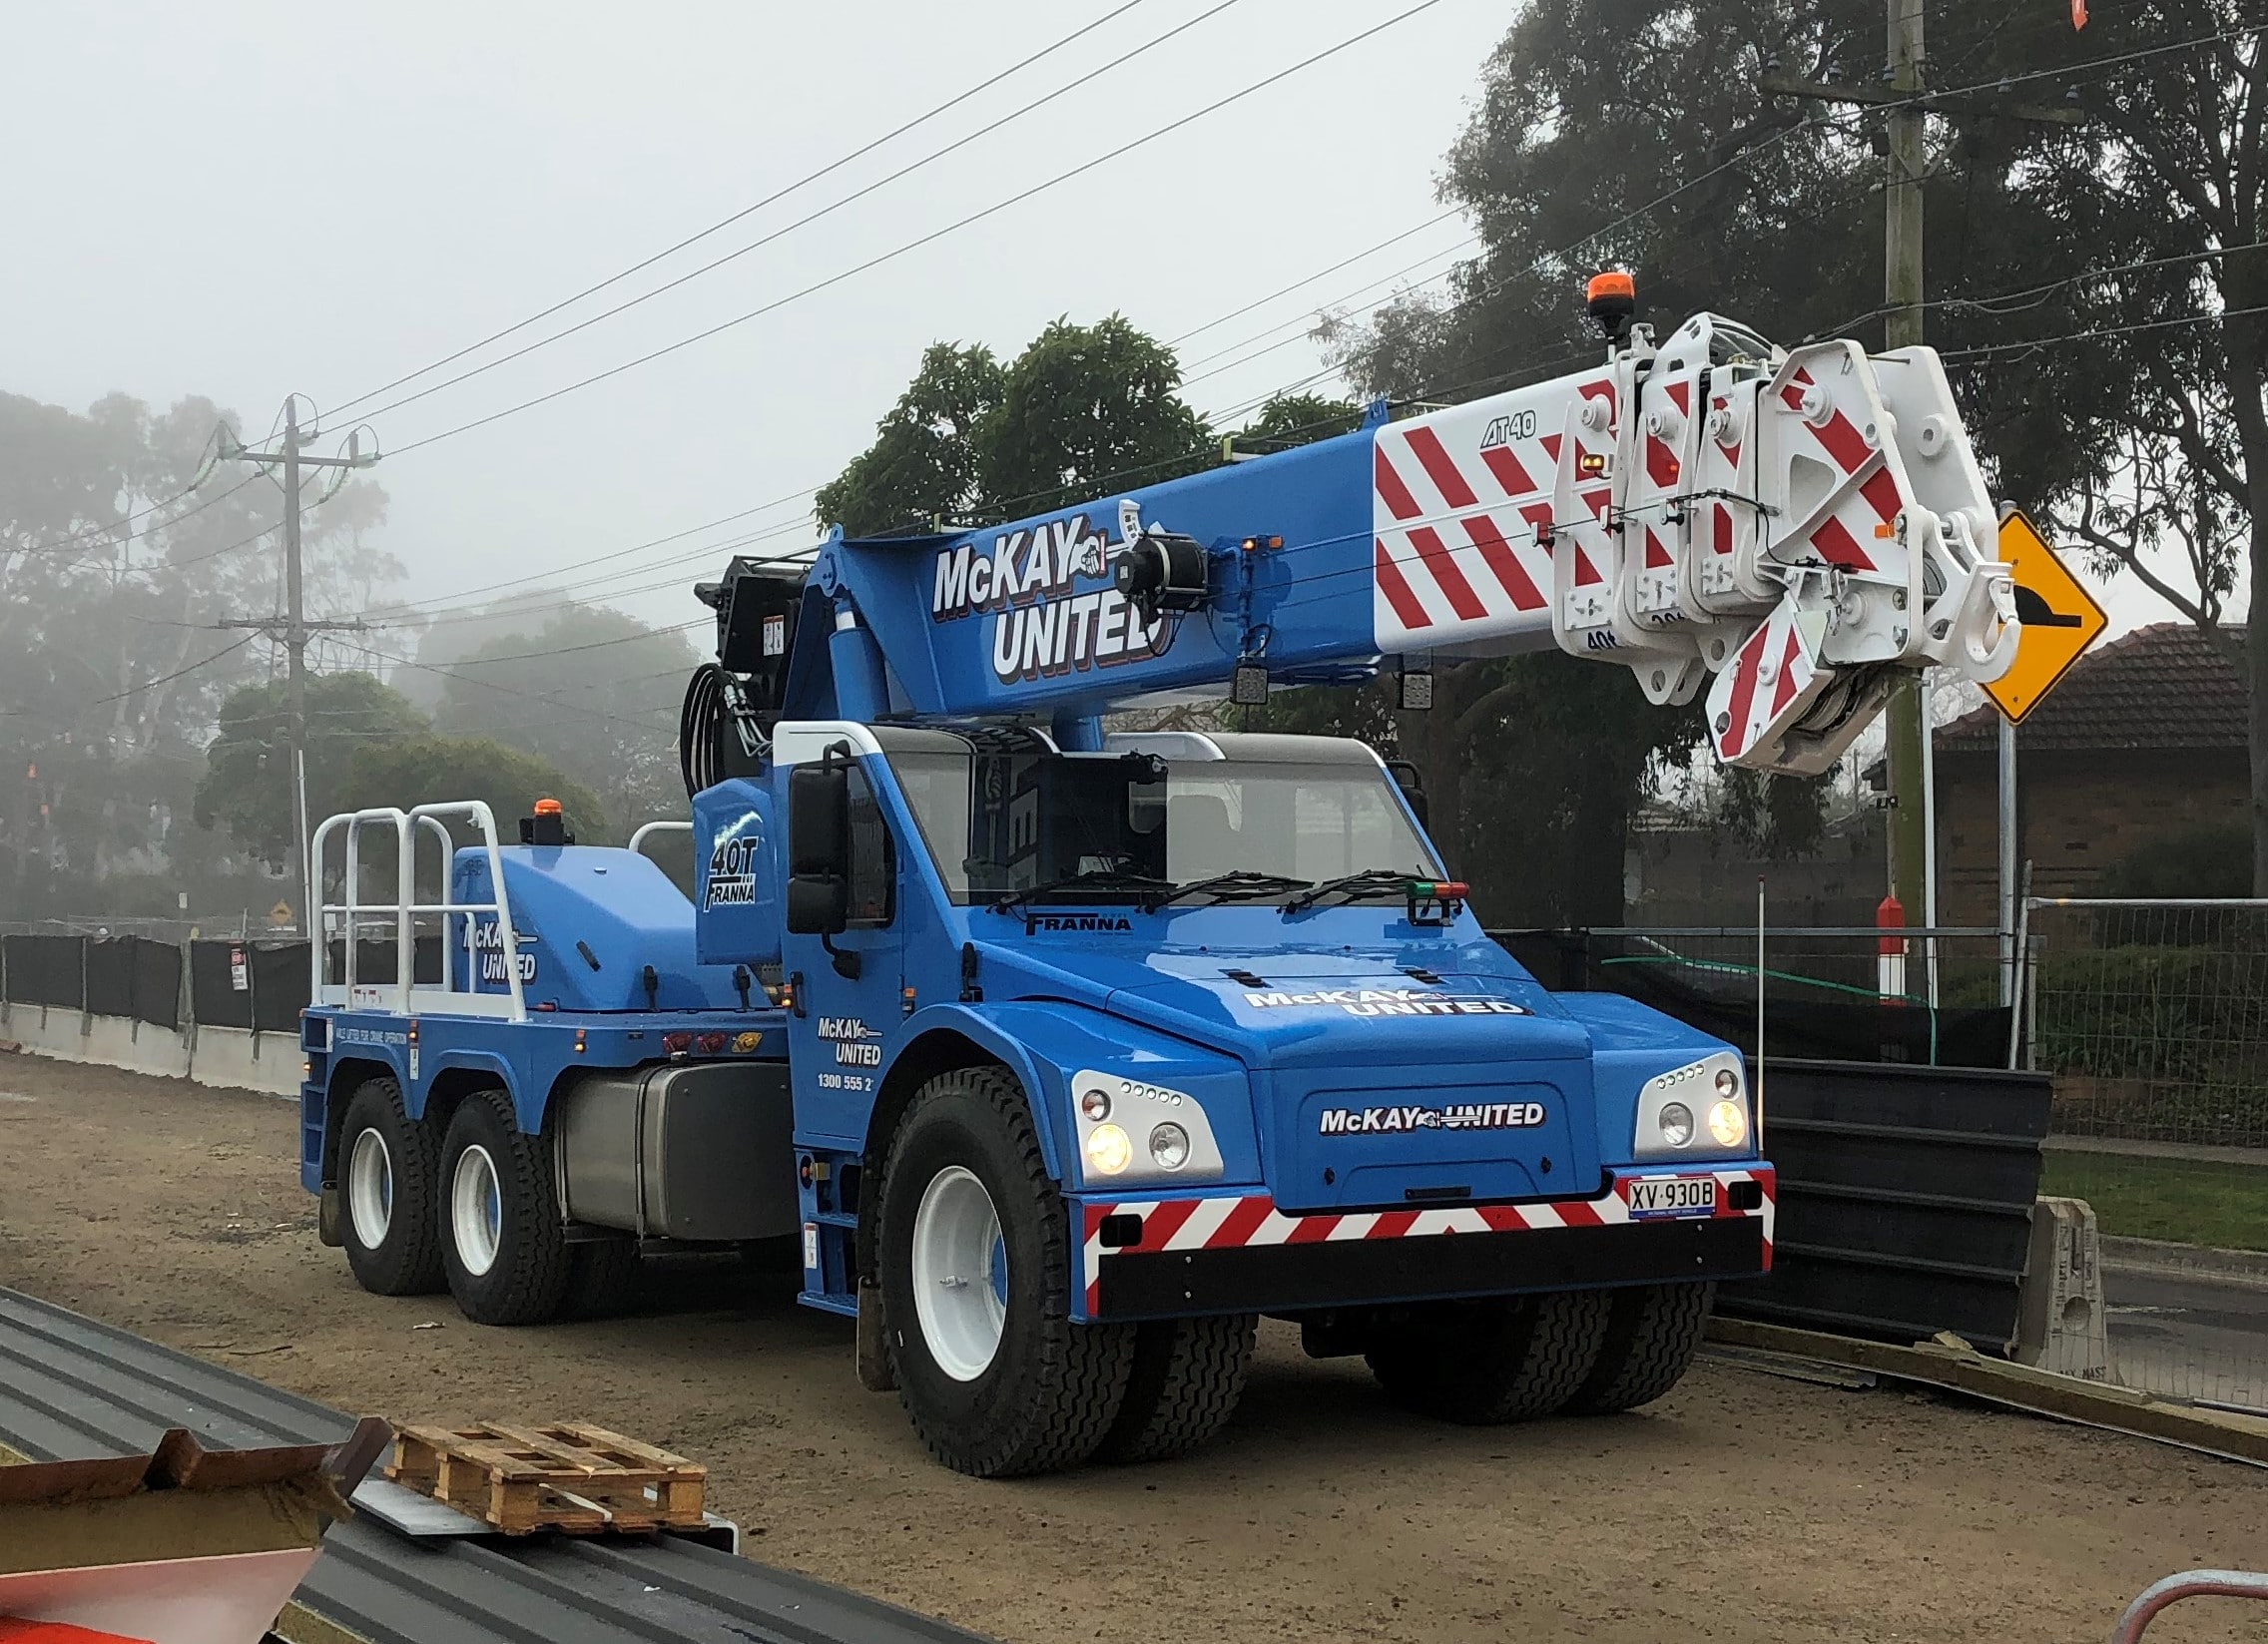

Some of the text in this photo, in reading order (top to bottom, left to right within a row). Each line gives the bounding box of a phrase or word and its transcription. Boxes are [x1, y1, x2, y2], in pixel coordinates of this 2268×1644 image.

[1480, 409, 1536, 449] AT40
[932, 516, 1084, 613] McKAY
[709, 836, 759, 875] 40T
[703, 875, 756, 912] FRANNA
[1025, 912, 1133, 936] FRANNA
[482, 953, 536, 980] UNIED
[1244, 990, 1410, 1007] McKAY
[1347, 1001, 1527, 1016] UNITED
[818, 1017, 861, 1039] McKAY
[836, 1042, 881, 1066] UNITED
[818, 1073, 842, 1090] 1300
[844, 1075, 863, 1091] 555
[1320, 1102, 1544, 1132] McKAY UNITED
